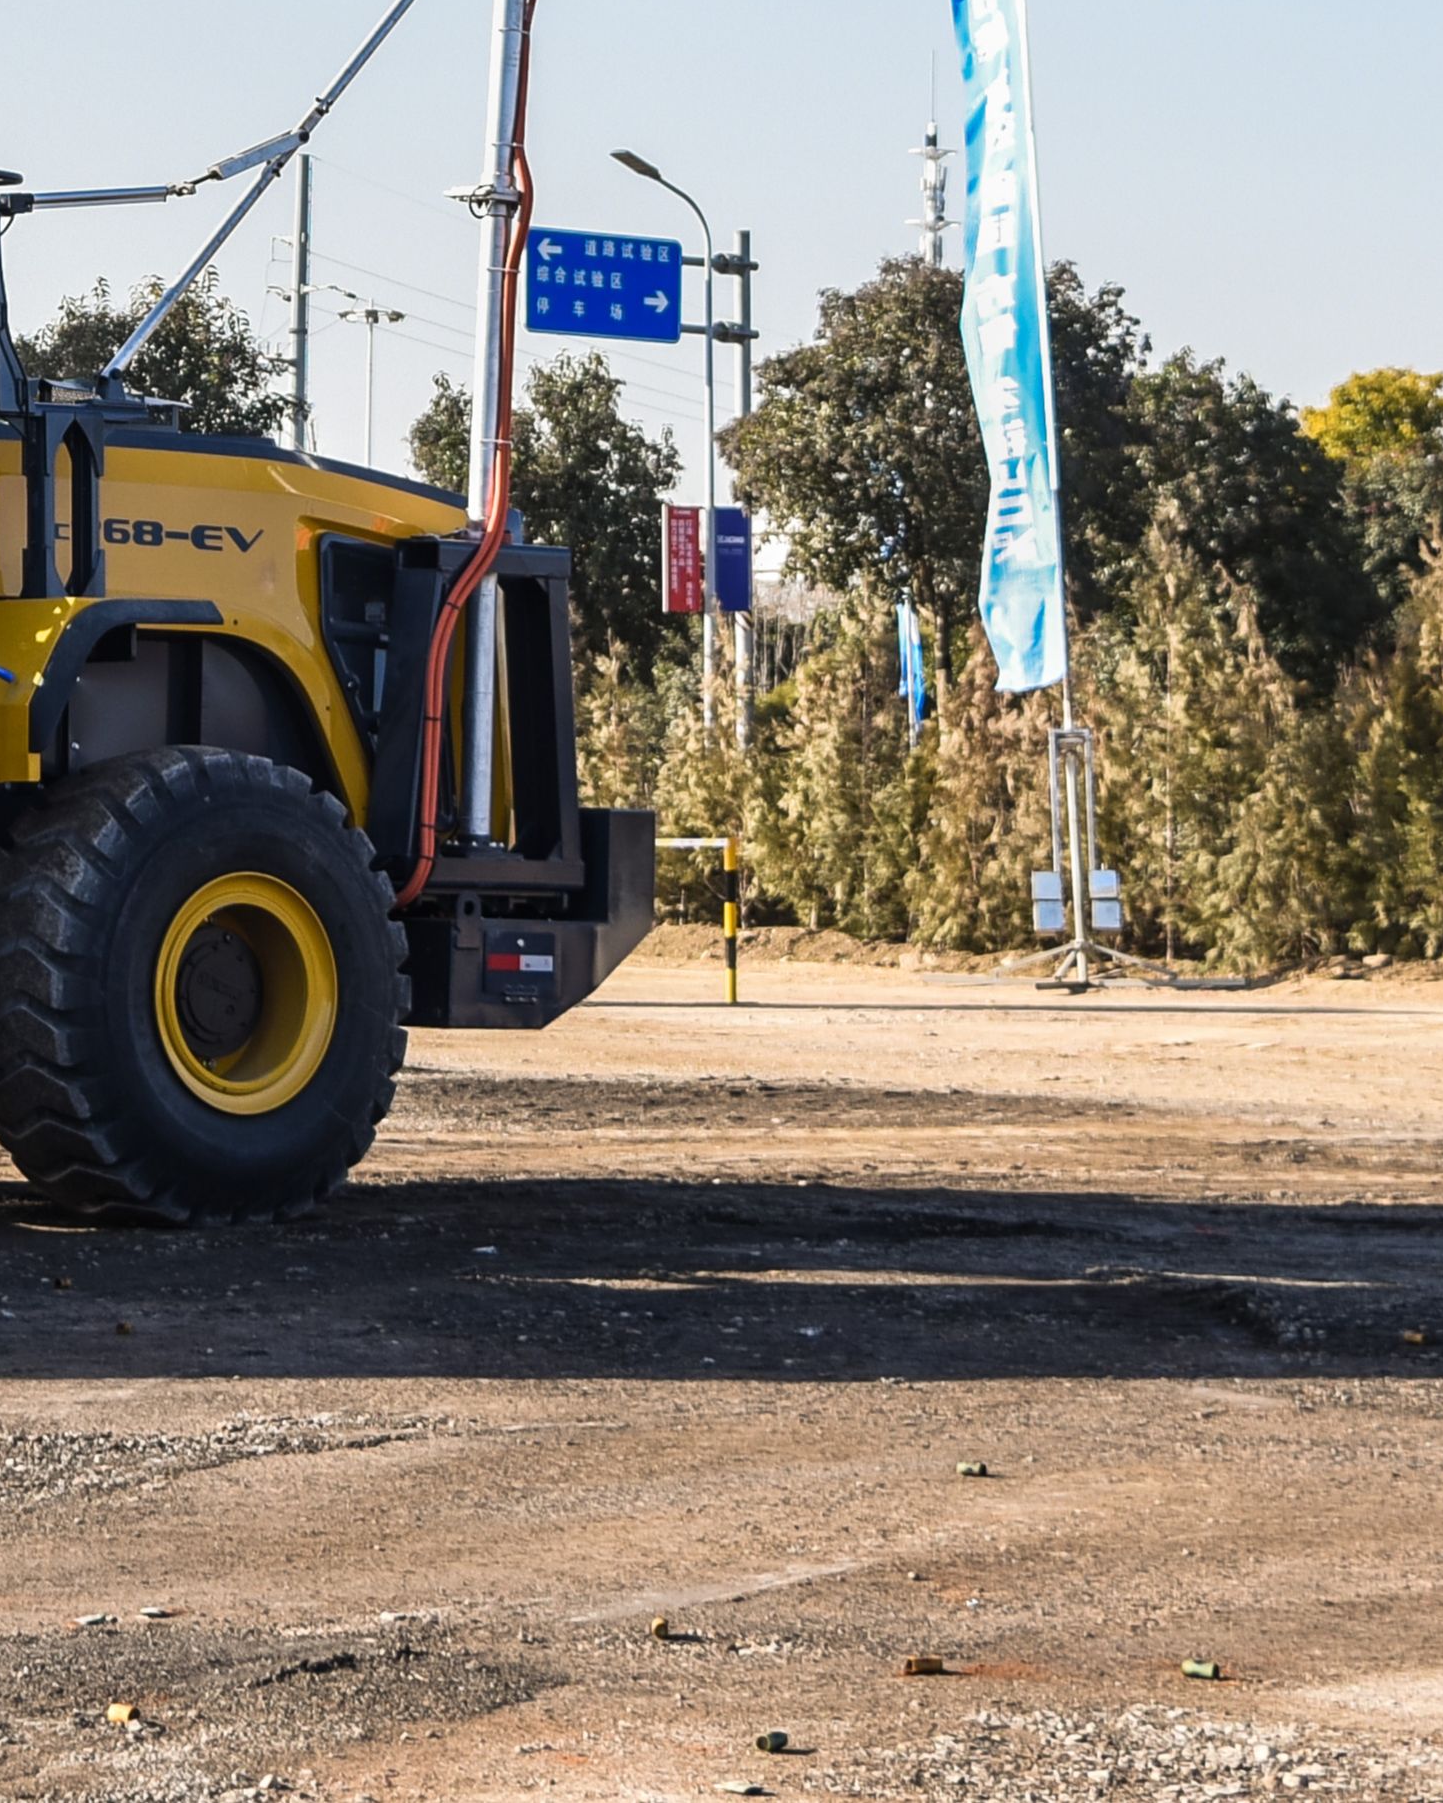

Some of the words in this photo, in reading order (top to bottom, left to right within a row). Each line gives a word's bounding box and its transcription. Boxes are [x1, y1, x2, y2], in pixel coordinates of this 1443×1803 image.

[584, 239, 669, 262] 道路试验区
[536, 265, 622, 289] 综合试验区
[536, 296, 623, 321] 停车场
